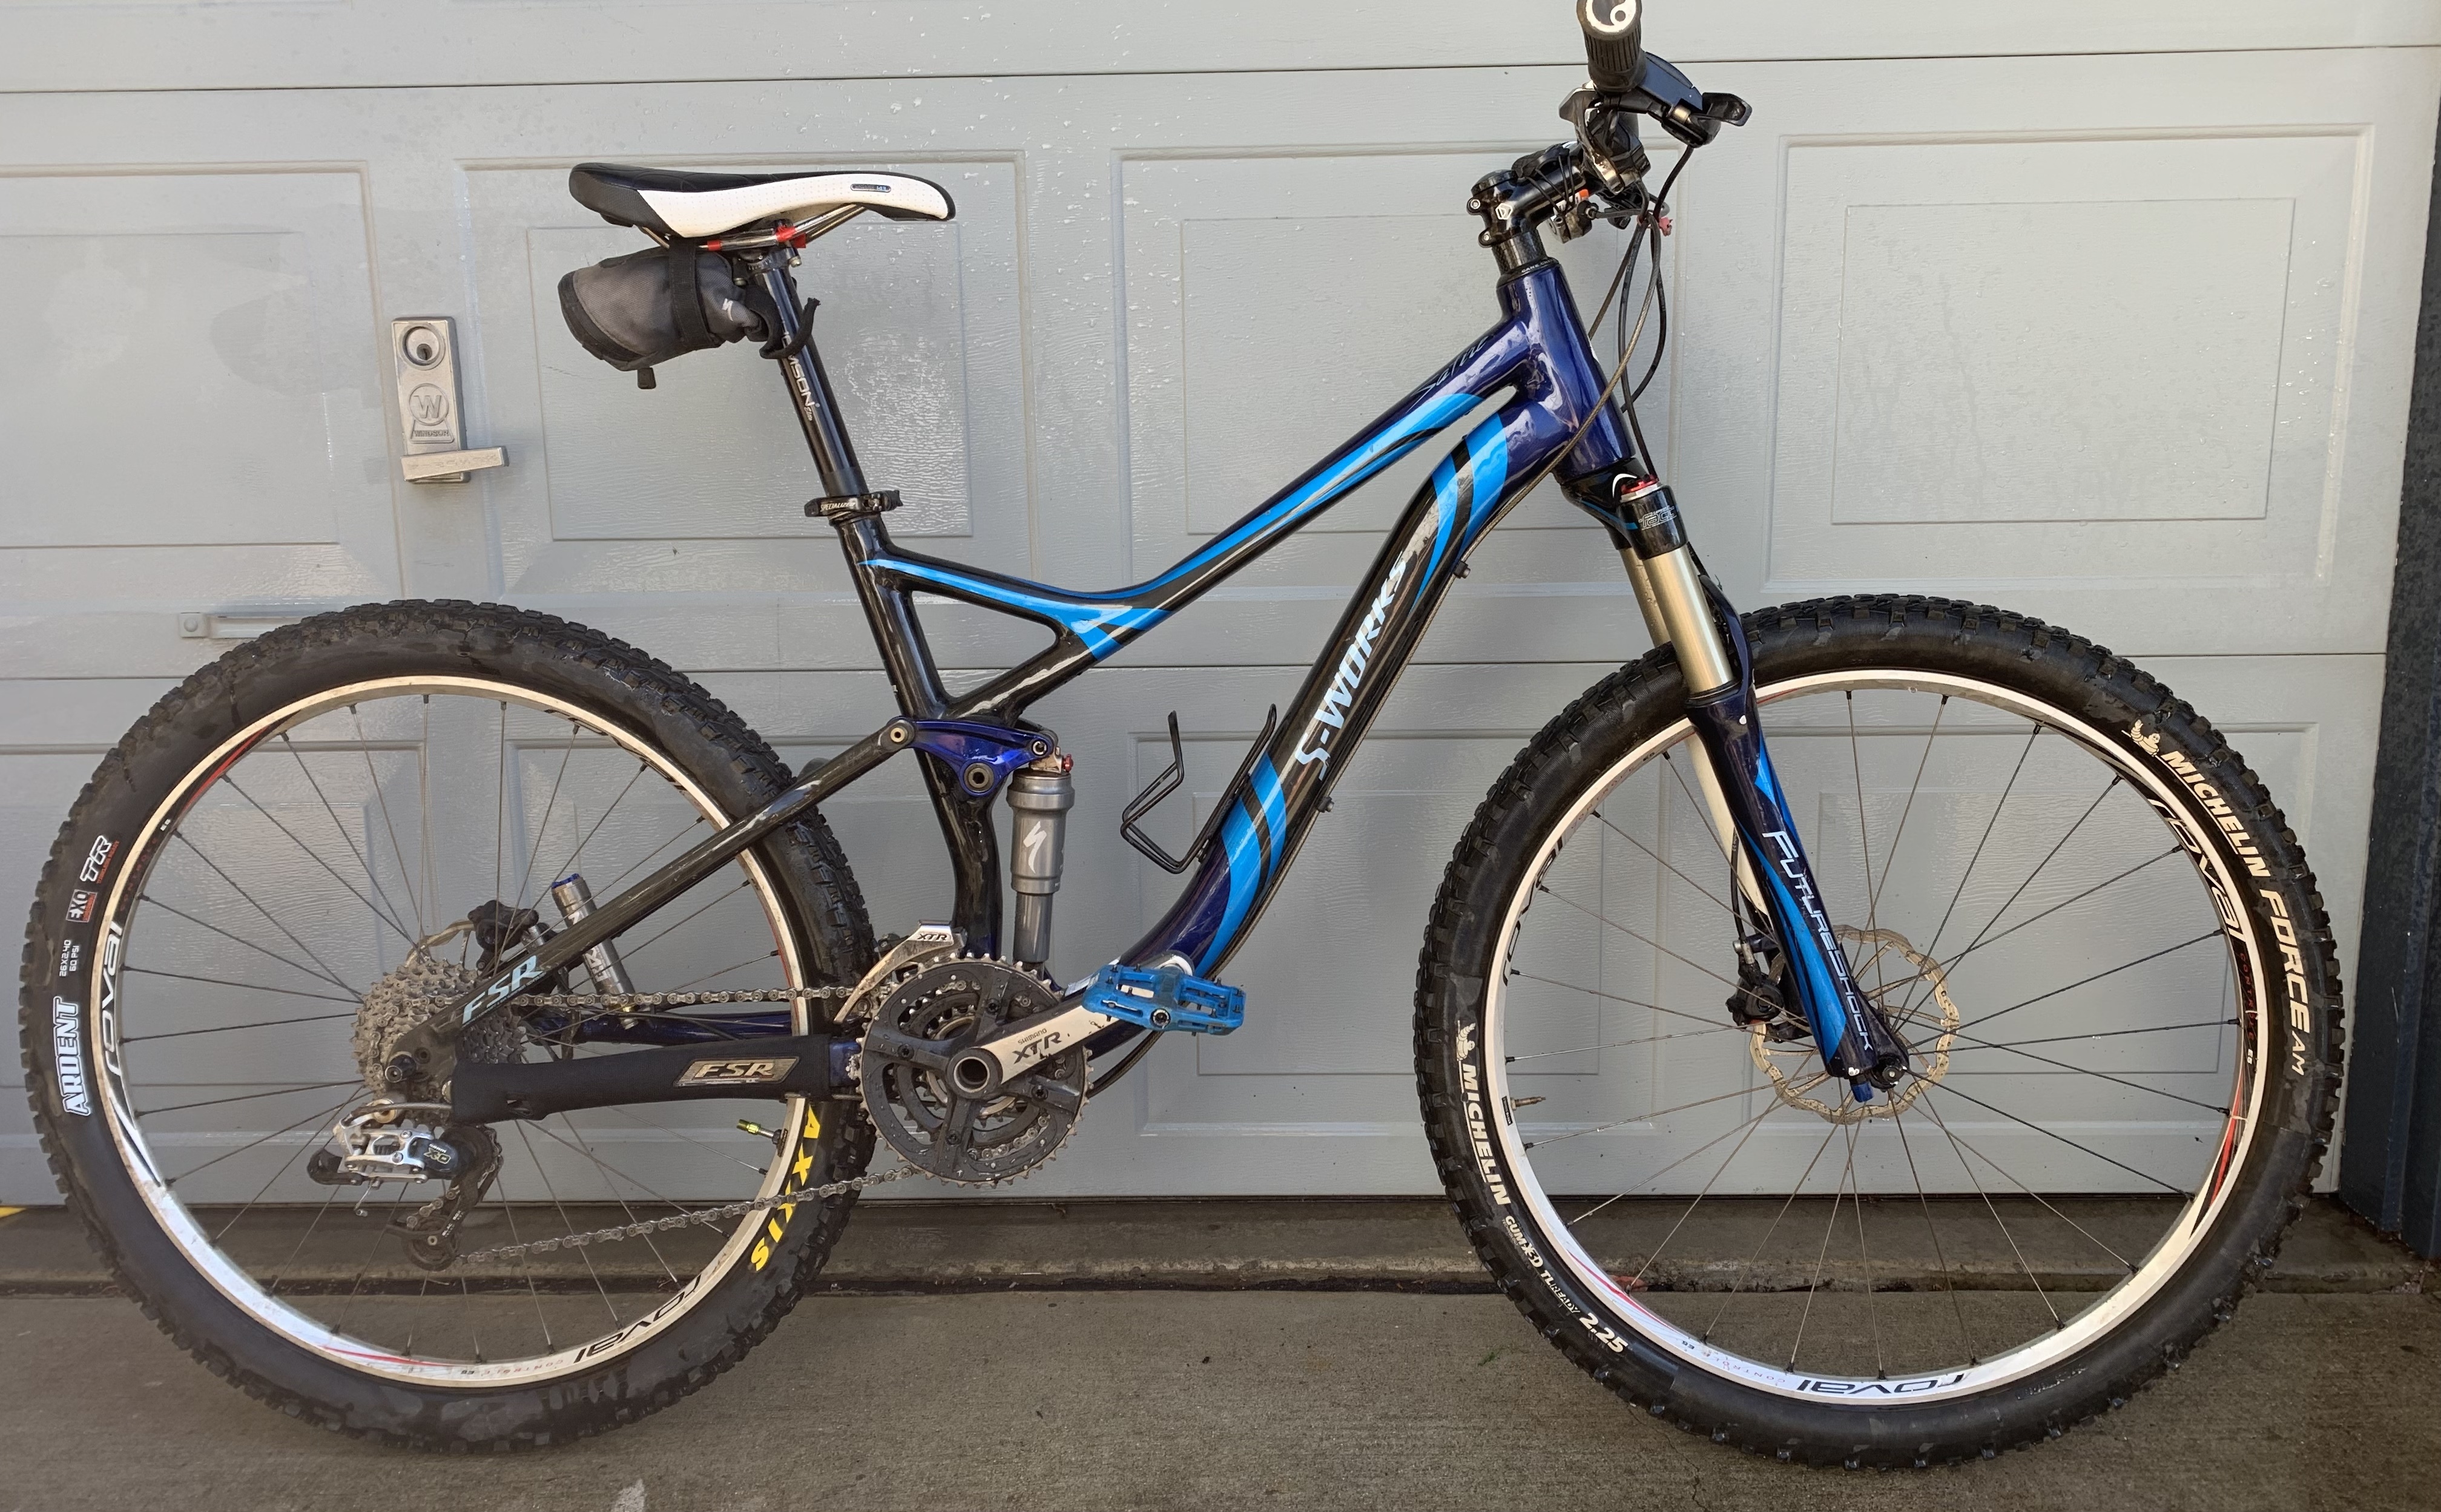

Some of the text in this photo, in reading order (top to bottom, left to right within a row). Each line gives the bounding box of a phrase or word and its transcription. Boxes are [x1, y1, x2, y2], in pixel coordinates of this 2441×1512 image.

[414, 395, 441, 419] W
[820, 502, 856, 512] SPECIALIZED
[1295, 550, 1406, 781] S-WORKS
[79, 835, 112, 882] TR
[2147, 798, 2246, 943] roval
[68, 890, 90, 919] EXO
[1503, 835, 1563, 987] roval
[2160, 751, 2310, 1076] MICHELIN FORCE AM
[69, 962, 77, 971] 60
[1762, 830, 1873, 1051] FUTURESHOCK
[102, 920, 123, 1077] roval
[463, 955, 544, 1024] FSR
[53, 996, 91, 1117] ARDENT
[1012, 1031, 1062, 1064] XTR
[1018, 1028, 1047, 1045] SHIMANO
[694, 1062, 775, 1079] FSR
[1462, 1063, 1512, 1205] MICHELIN
[573, 1273, 702, 1364] roval
[1579, 1312, 1629, 1353] 2.25
[1796, 1373, 1965, 1395] roval
